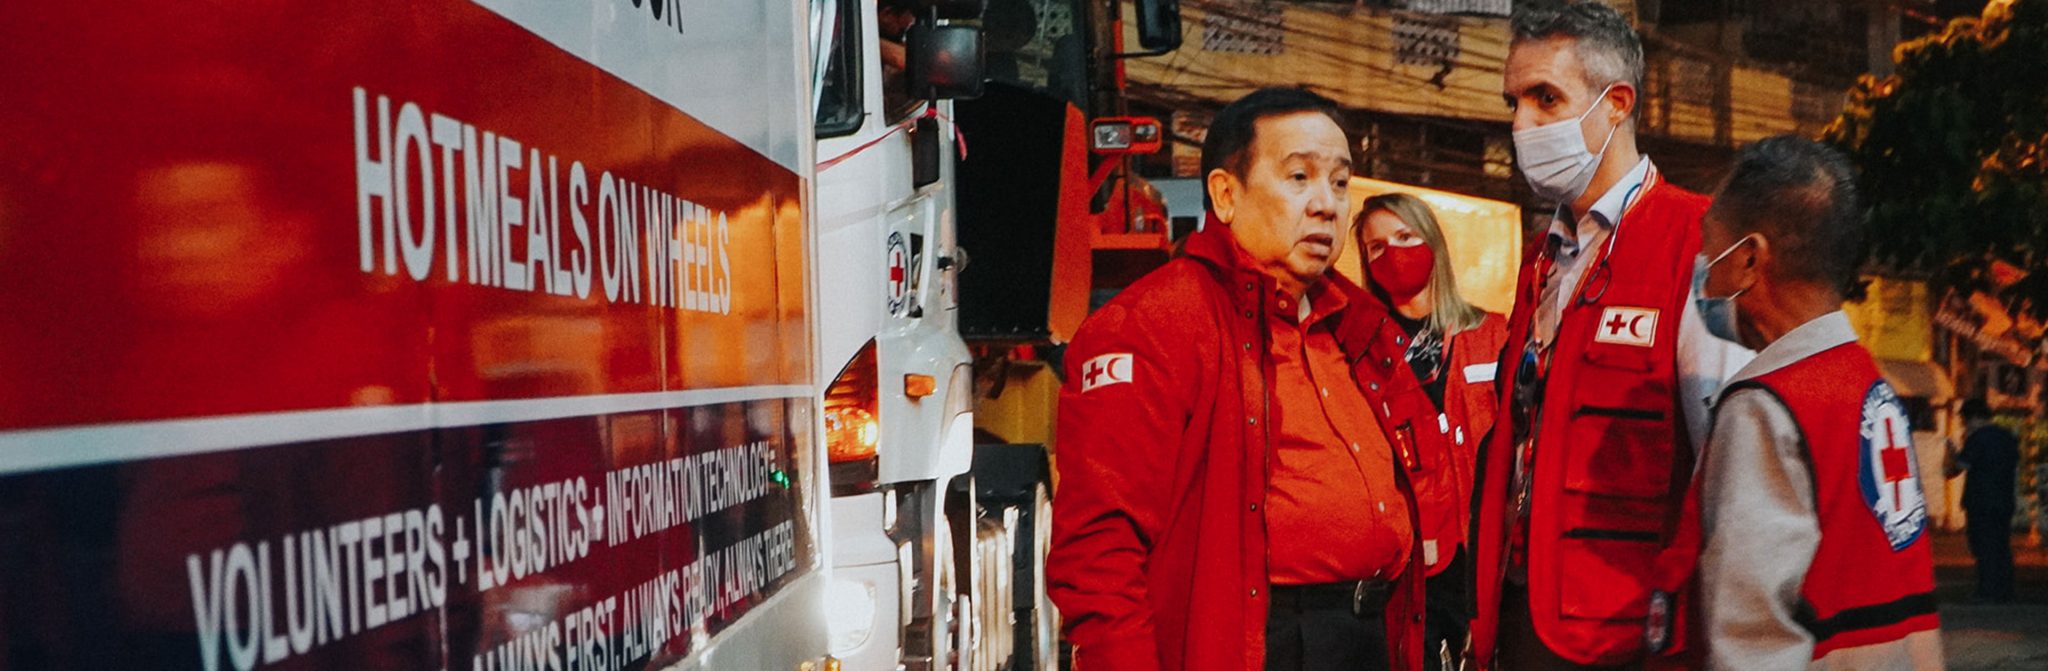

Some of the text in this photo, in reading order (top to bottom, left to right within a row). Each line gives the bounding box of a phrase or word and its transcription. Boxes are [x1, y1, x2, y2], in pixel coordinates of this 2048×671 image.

[353, 86, 592, 301] HOTMEALS
[598, 170, 640, 304] ON
[643, 186, 731, 316] WHEELS
[186, 503, 447, 671] VOLUNTEERS
[452, 516, 470, 585] +
[475, 476, 589, 592] LOGISTICS
[606, 454, 702, 548] INFORMATION
[702, 441, 769, 514] TECHNOLOGY
[623, 569, 681, 668] ALWAYS
[725, 532, 765, 607] ALWAYS
